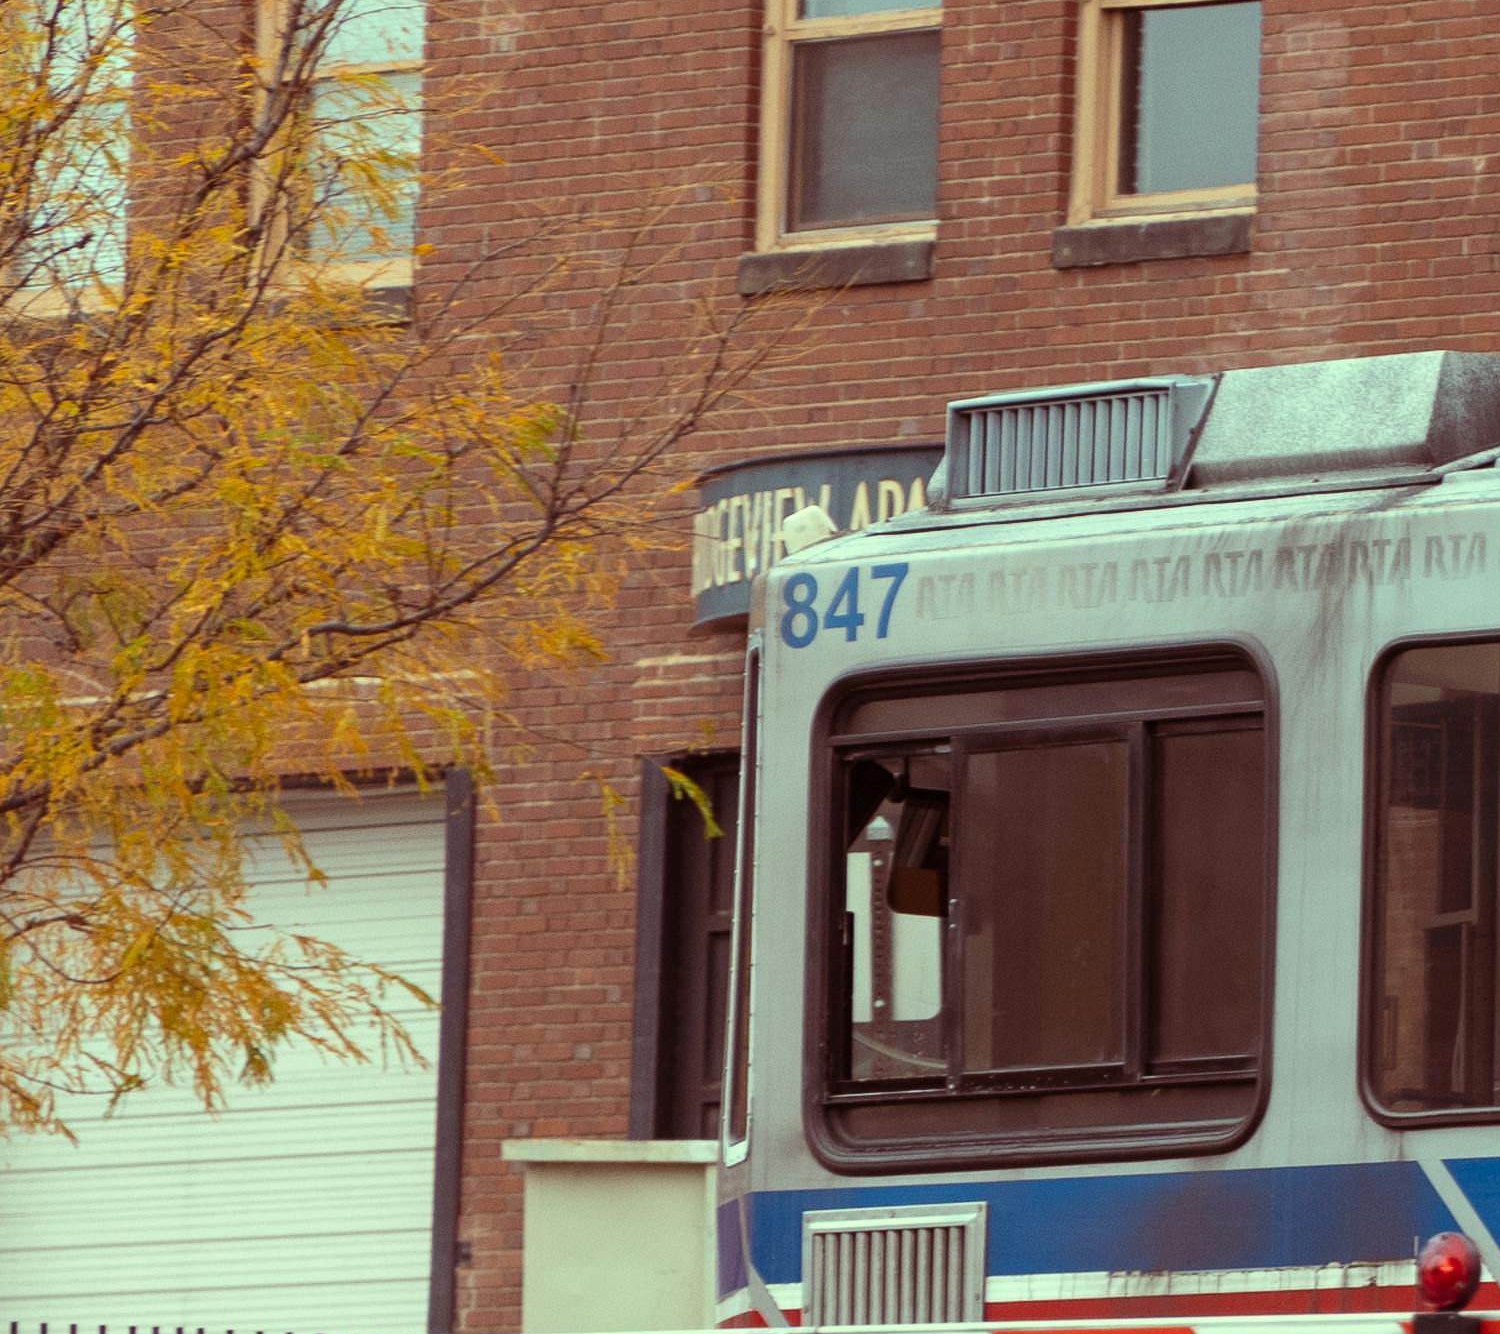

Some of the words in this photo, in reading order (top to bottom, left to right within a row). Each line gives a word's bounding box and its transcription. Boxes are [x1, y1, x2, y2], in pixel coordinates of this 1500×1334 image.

[781, 562, 910, 649] 847
[1128, 555, 1191, 603] RTA
[1201, 549, 1263, 598] RTA
[1422, 532, 1487, 580] RTA
